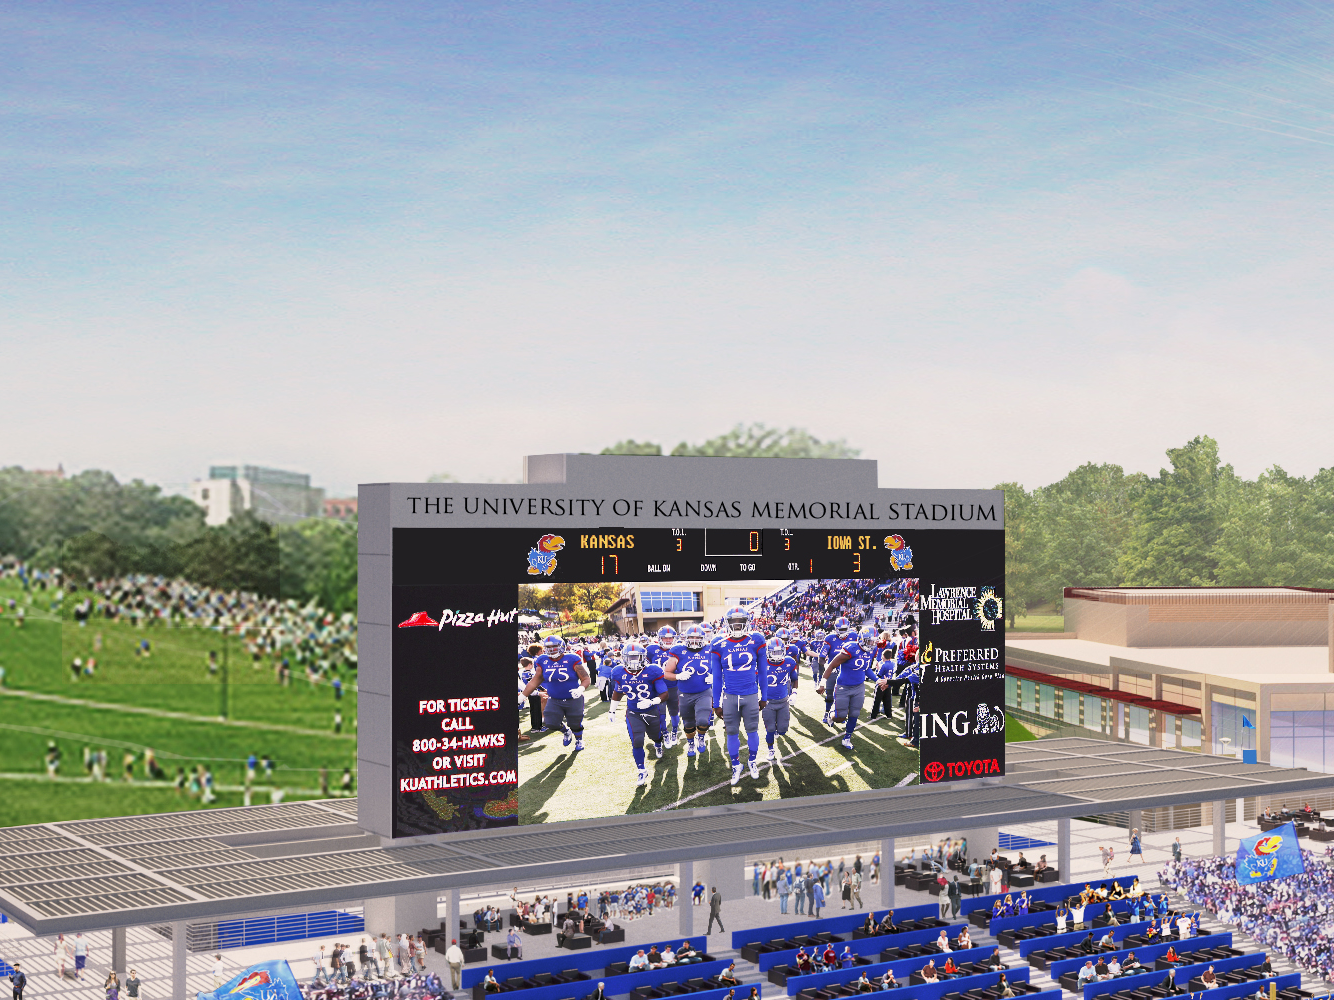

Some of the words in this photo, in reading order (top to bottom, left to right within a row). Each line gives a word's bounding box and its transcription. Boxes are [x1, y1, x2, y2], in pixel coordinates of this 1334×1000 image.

[407, 497, 454, 515] THE
[463, 497, 605, 516] UNIVERSITY
[612, 498, 644, 516] OF
[653, 499, 742, 519] KANSAS
[751, 501, 880, 520] MEMORIAL
[888, 503, 998, 522] STADIUM
[580, 534, 635, 549] KANSAS
[827, 535, 852, 550] IOWA
[858, 535, 877, 550] ST.
[601, 553, 618, 575] 17
[853, 553, 861, 573] 3
[438, 609, 485, 631] Pizza
[487, 607, 518, 627] Hut
[723, 652, 753, 672] 12
[935, 647, 999, 662] PREFERRED
[545, 668, 570, 682] 75
[682, 660, 709, 676] 65
[419, 700, 446, 715] FOR
[447, 697, 500, 714] TICKETS
[441, 717, 474, 732] CALL
[919, 710, 971, 739] ING
[412, 733, 506, 753] 800-34-HAWKS
[432, 756, 452, 770] OR
[454, 753, 487, 769] VISIT
[947, 758, 1001, 777] TOYOTA
[400, 770, 517, 792] KUATHLETICS.COM
